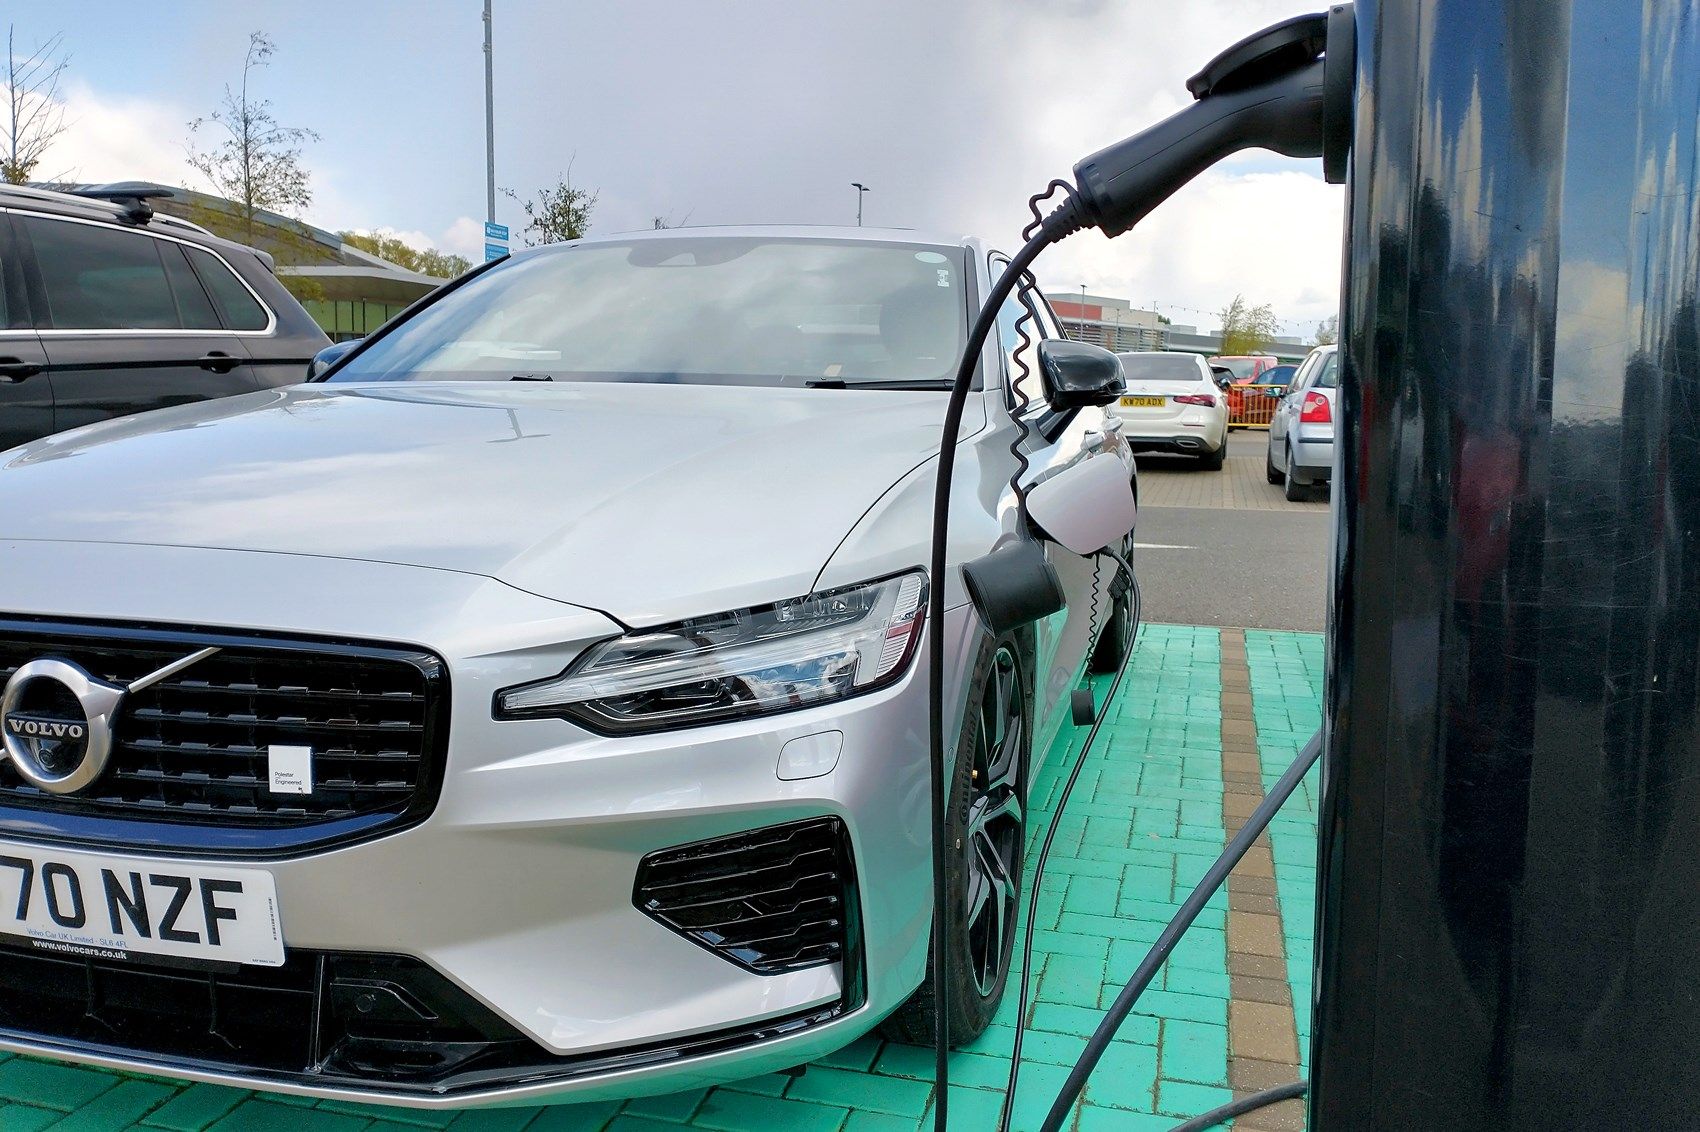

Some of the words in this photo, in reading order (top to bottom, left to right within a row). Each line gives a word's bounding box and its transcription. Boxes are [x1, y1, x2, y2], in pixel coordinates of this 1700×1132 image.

[8, 718, 84, 738] VOLVO
[0, 855, 87, 929] 70
[101, 869, 243, 946] NZF
[27, 928, 44, 937] Volvo
[45, 930, 57, 939] Car
[58, 932, 69, 940] UK
[70, 933, 94, 943] Limited
[32, 940, 127, 960] www.volvocars.co.uk
